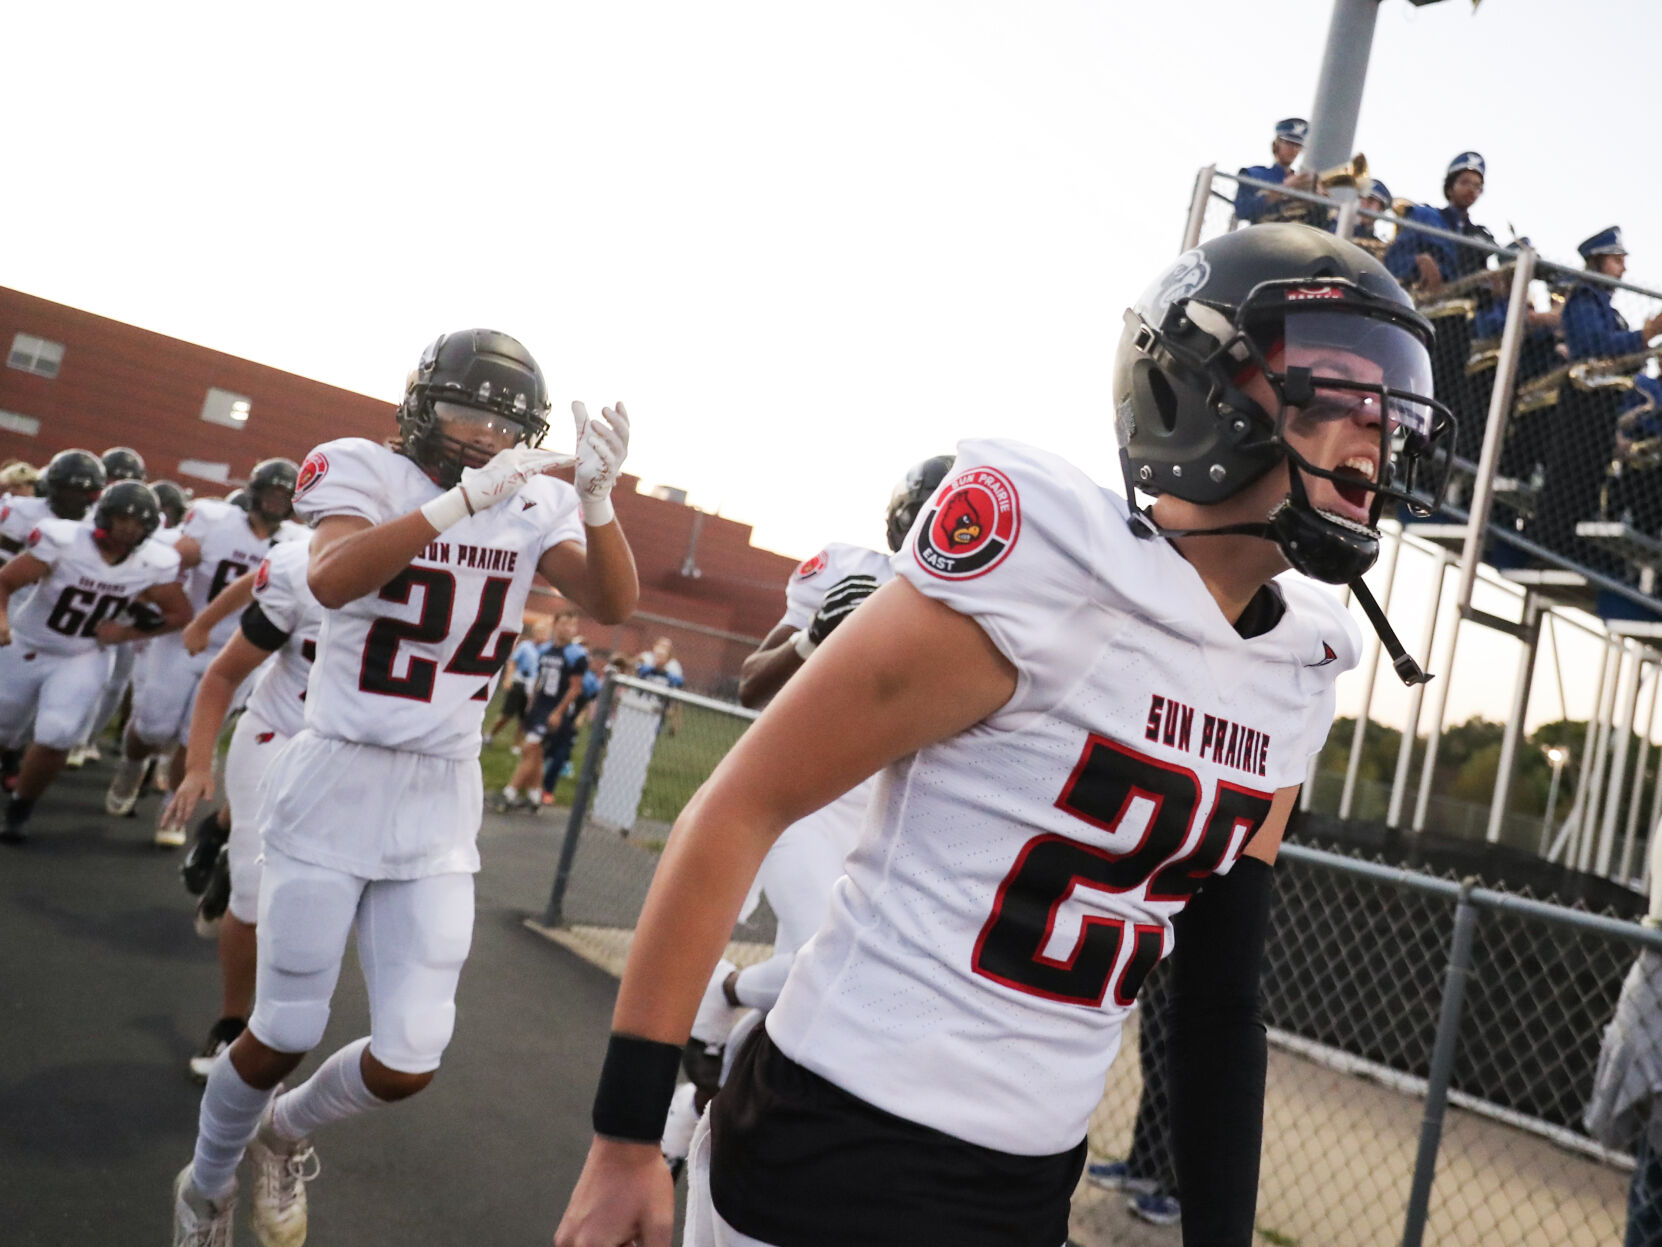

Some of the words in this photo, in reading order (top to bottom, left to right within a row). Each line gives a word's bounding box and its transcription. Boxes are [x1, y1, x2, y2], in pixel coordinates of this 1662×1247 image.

[978, 473, 1010, 513] PRAIRIE
[457, 544, 518, 572] PRAIRIE
[922, 547, 955, 570] EAST
[358, 564, 519, 703] 24
[1145, 694, 1195, 752] SUN
[1199, 713, 1270, 776] PRAIRIE
